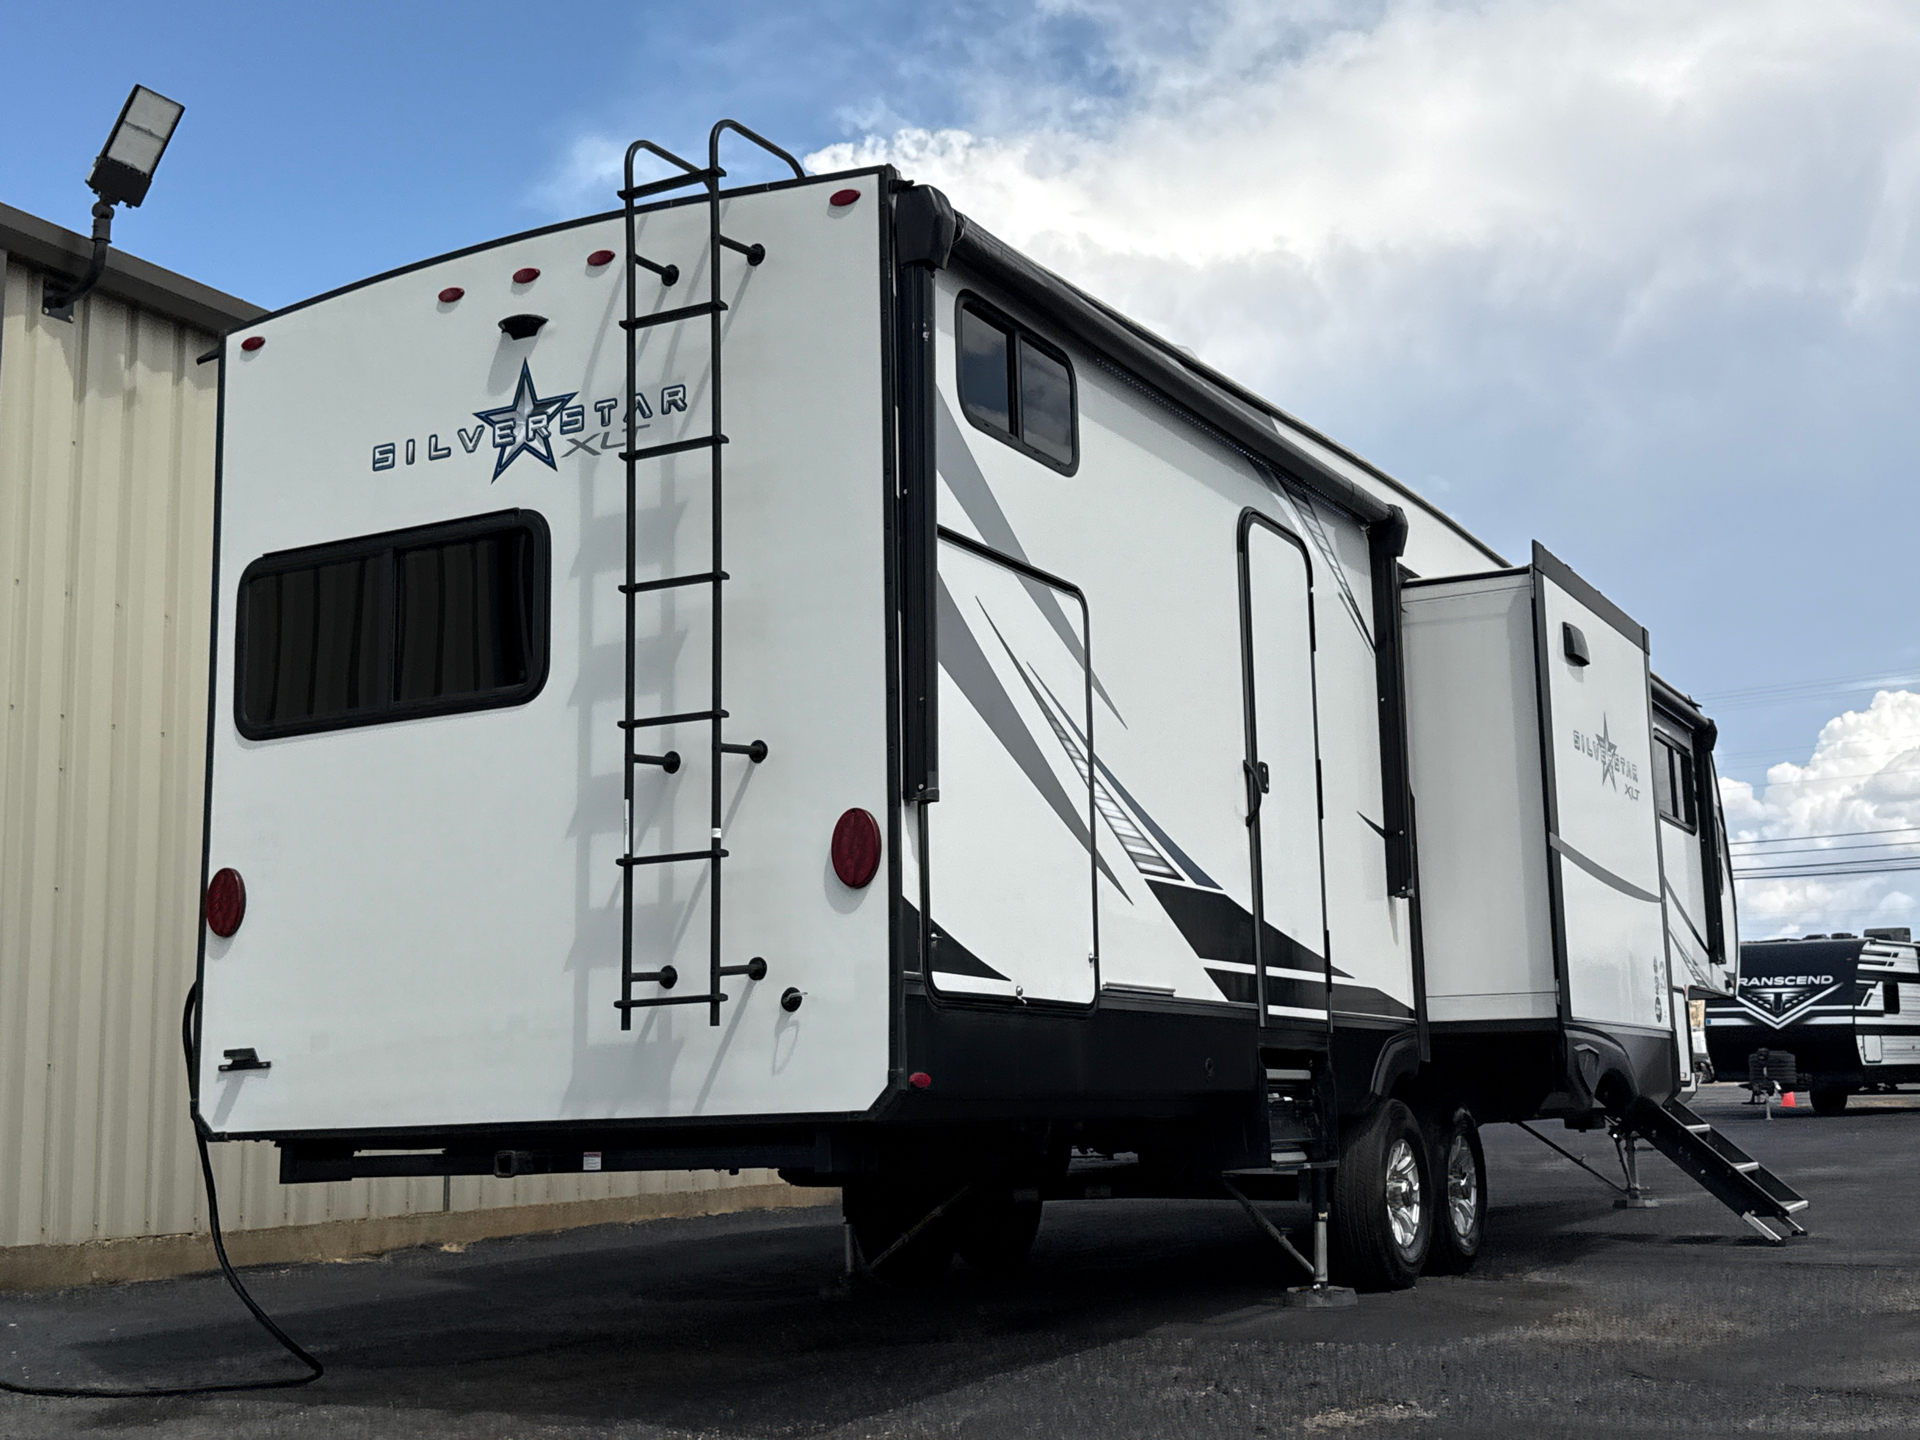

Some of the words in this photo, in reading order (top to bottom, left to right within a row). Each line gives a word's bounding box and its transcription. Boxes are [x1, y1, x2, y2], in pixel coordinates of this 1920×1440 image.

[372, 384, 687, 472] SILVERSTAR
[1625, 783, 1640, 801] XLT
[1739, 975, 1834, 987] RANSCEND
